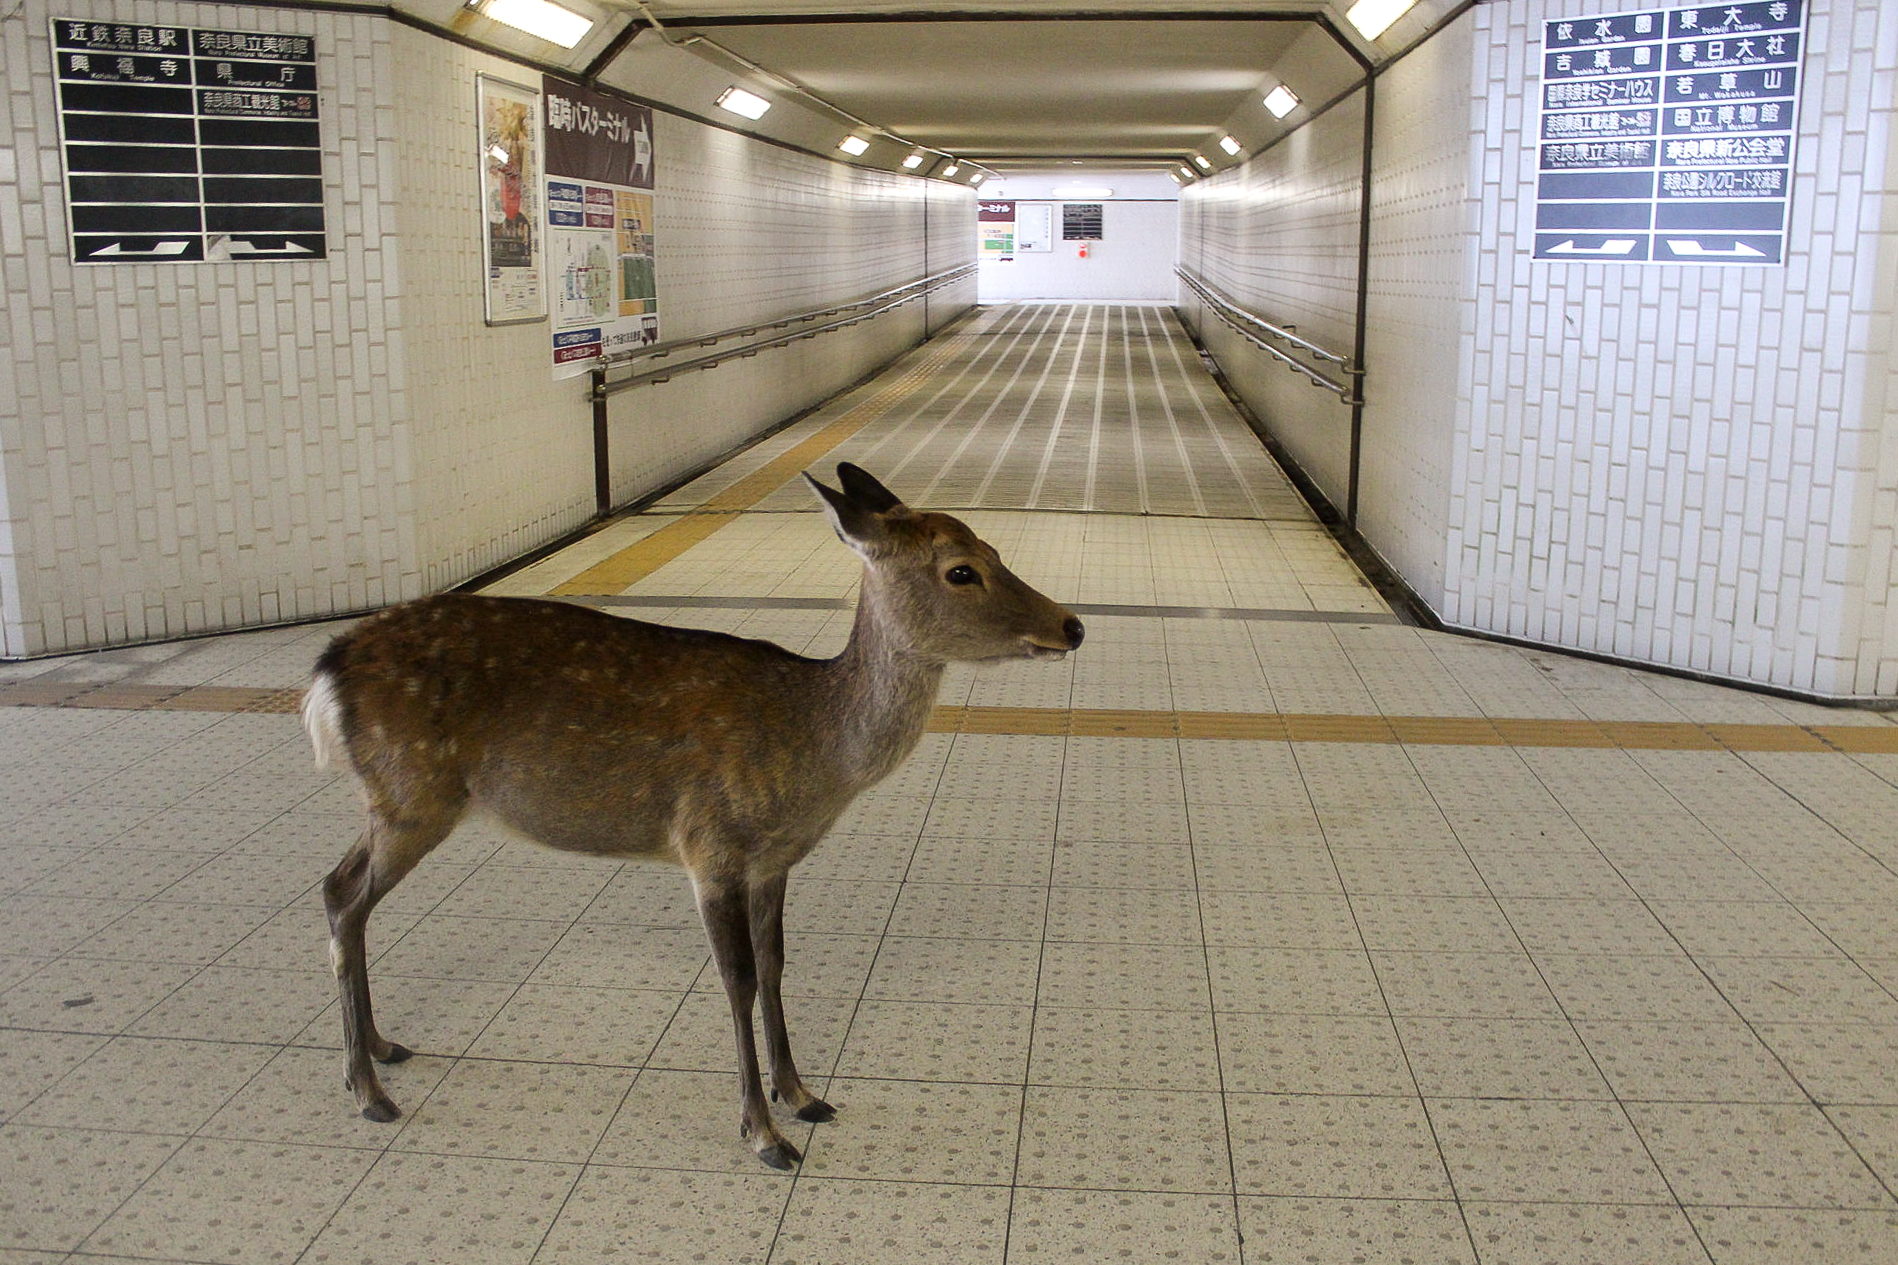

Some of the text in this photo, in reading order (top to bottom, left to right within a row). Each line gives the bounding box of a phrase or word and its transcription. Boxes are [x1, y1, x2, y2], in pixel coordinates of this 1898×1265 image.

[1680, 2, 1788, 29] 東大寺
[68, 23, 178, 46] 近鉄奈良駅
[199, 33, 308, 54] 奈良県立美術館
[1679, 35, 1785, 62] 春日大社
[70, 55, 178, 76] 興福寺
[217, 63, 296, 82] 県庁
[1676, 70, 1782, 94] 若草山
[547, 94, 631, 144] 臨時バスターミナル
[1674, 103, 1780, 127] 国立博物館
[1666, 137, 1785, 160] 奈良県新公会堂
